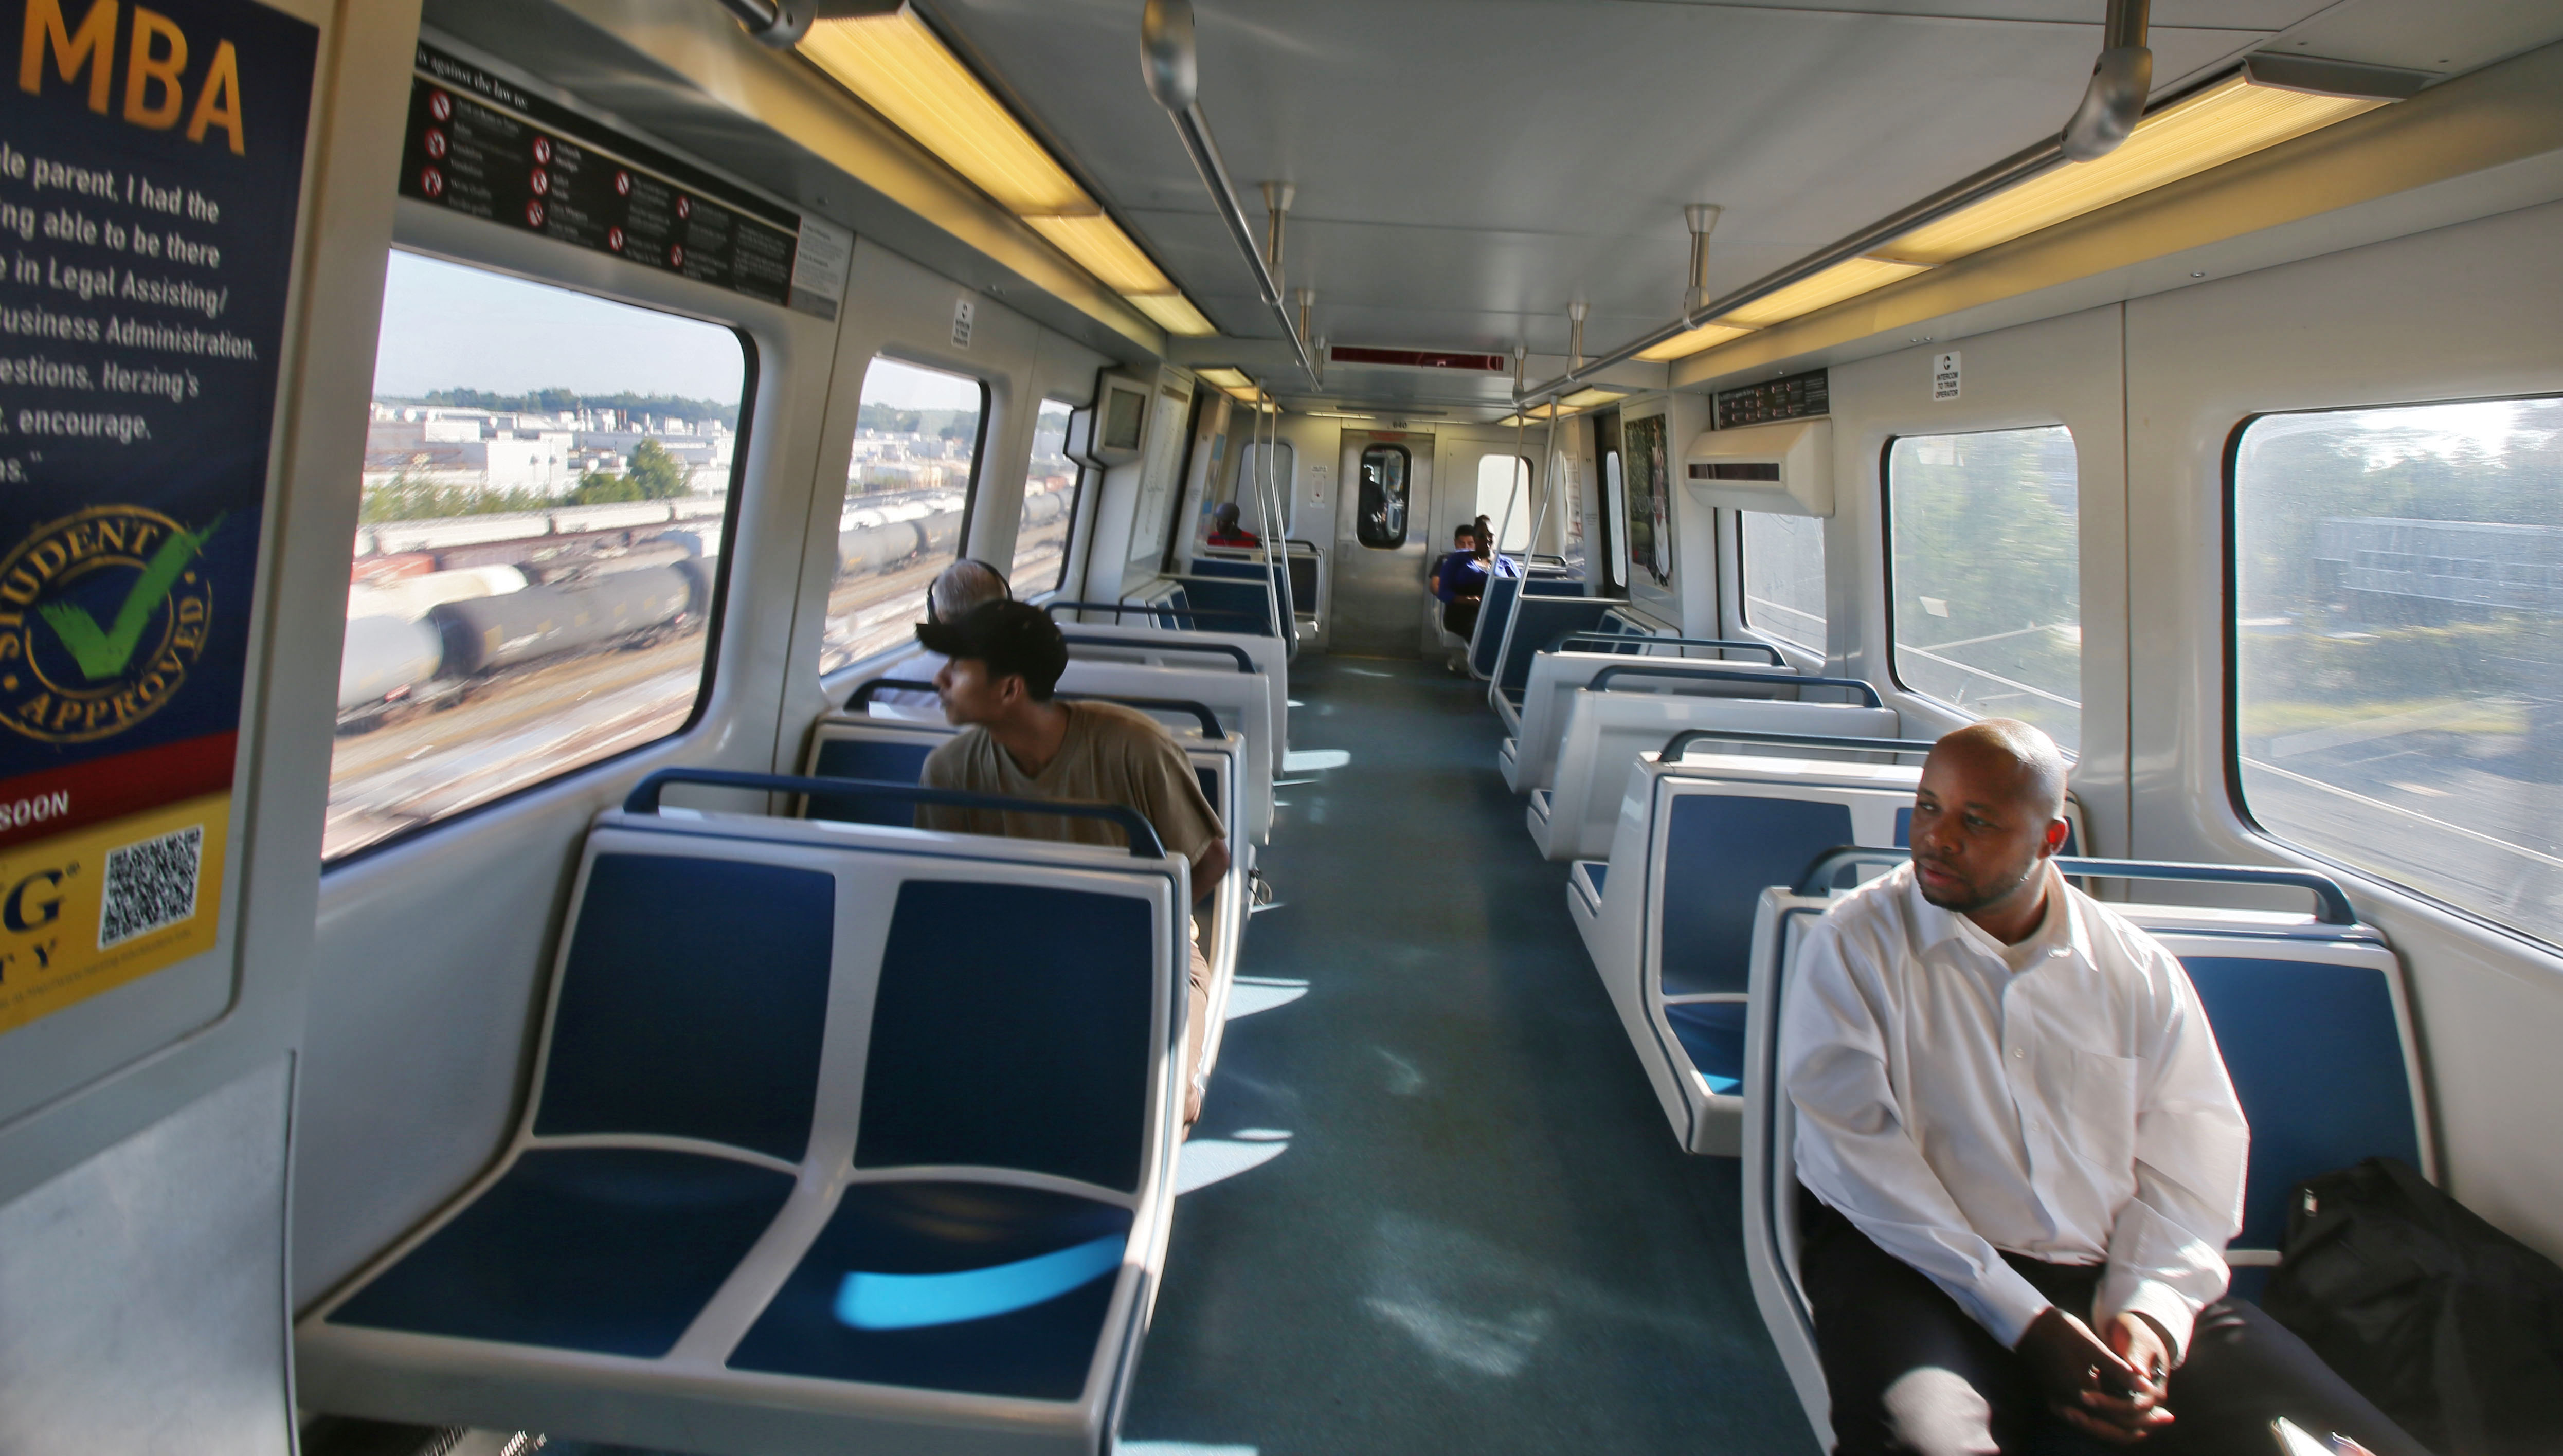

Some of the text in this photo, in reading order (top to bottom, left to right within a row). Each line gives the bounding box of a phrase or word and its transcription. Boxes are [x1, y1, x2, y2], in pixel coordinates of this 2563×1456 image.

[19, 0, 245, 156] MBA
[430, 57, 471, 86] against
[474, 71, 491, 95] the
[494, 79, 512, 102] law
[126, 174, 135, 205] I
[140, 177, 182, 215] had
[187, 187, 220, 225] the
[43, 207, 97, 246] able
[104, 219, 126, 251] to
[133, 222, 160, 257] be
[166, 231, 220, 269] there
[15, 249, 40, 286] in
[48, 256, 115, 301] Legal
[121, 269, 228, 319] Assisting/
[102, 361, 200, 404] Herzing's
[1935, 389, 1958, 399] OPERATOR
[1937, 372, 1958, 381] INTERCOM
[18, 596, 204, 731] APPROVED
[0, 790, 69, 832] SOON
